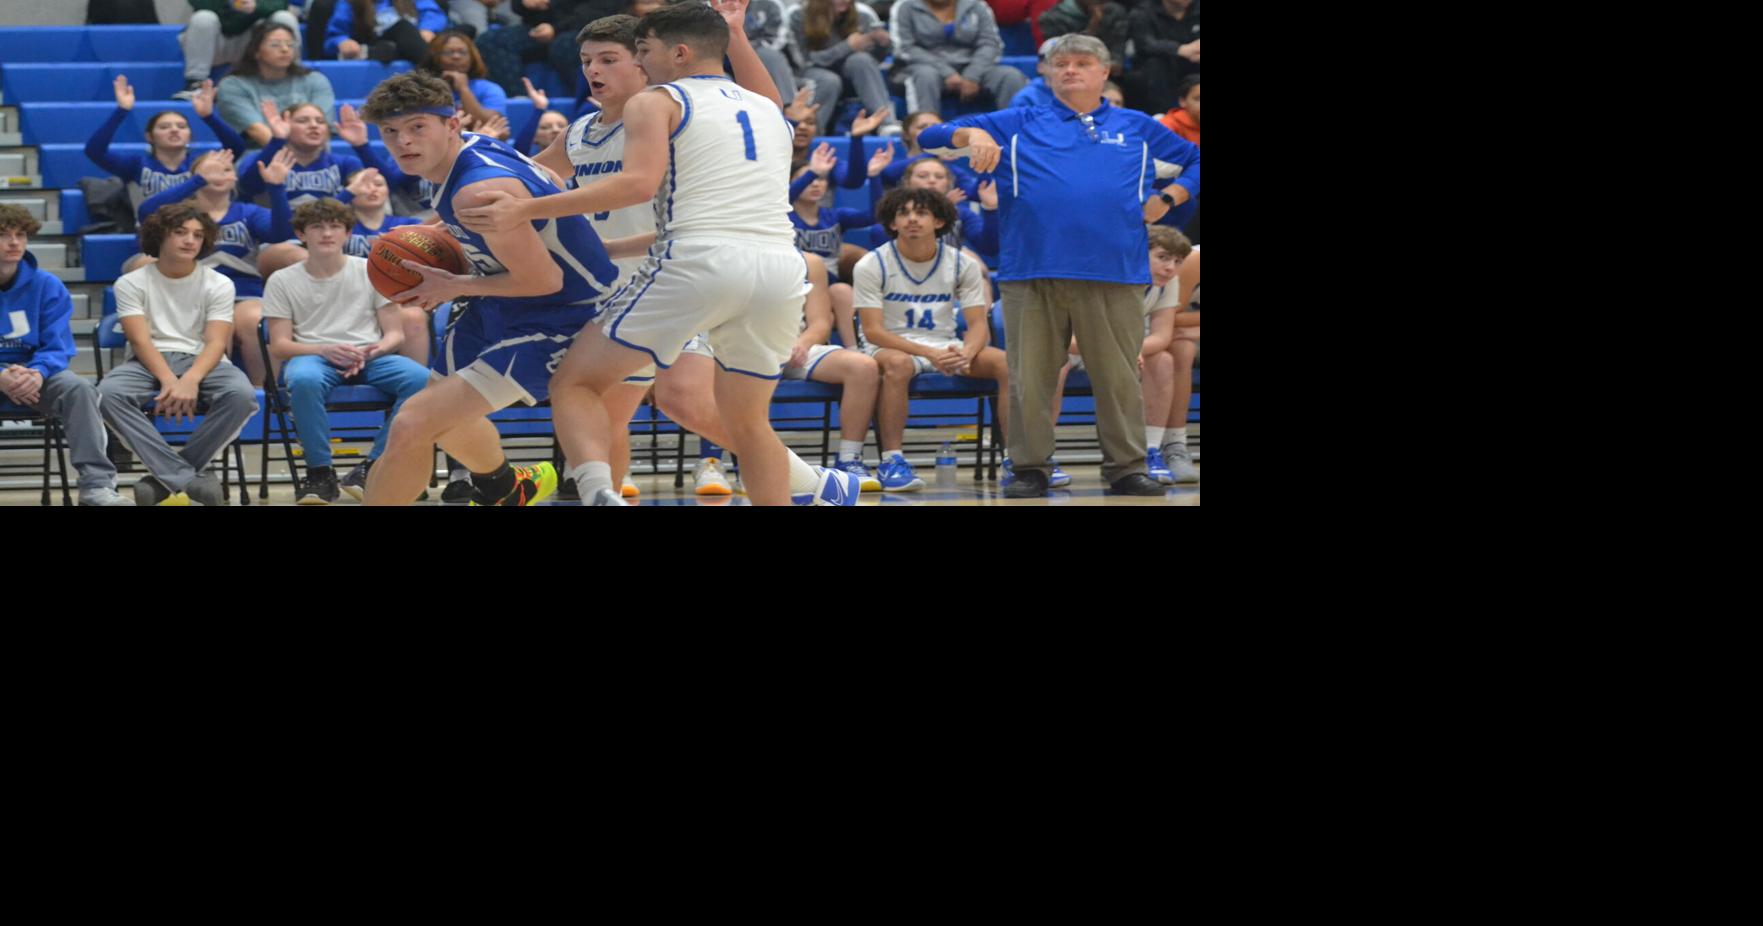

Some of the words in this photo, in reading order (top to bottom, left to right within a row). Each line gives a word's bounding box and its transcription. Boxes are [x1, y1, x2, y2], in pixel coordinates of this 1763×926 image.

[735, 110, 757, 161] 1
[285, 164, 342, 196] NION
[883, 292, 952, 303] UNION
[904, 308, 936, 330] 14
